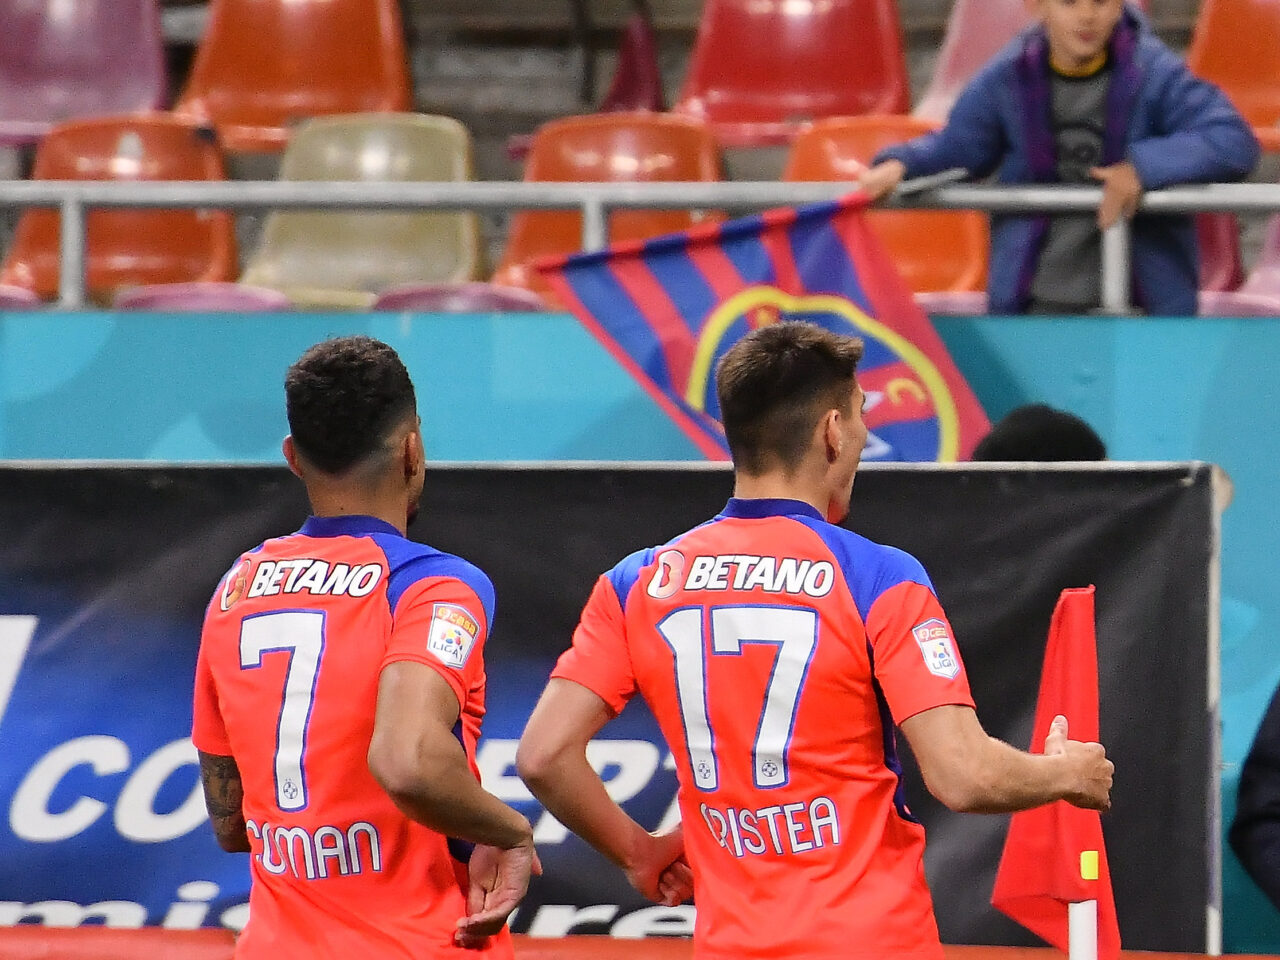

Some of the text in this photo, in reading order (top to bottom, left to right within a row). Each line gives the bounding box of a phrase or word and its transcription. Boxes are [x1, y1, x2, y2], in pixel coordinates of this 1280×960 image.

[248, 558, 383, 598] BETANO
[684, 554, 834, 597] BETANO
[239, 607, 327, 813] 7
[655, 604, 819, 792] 17
